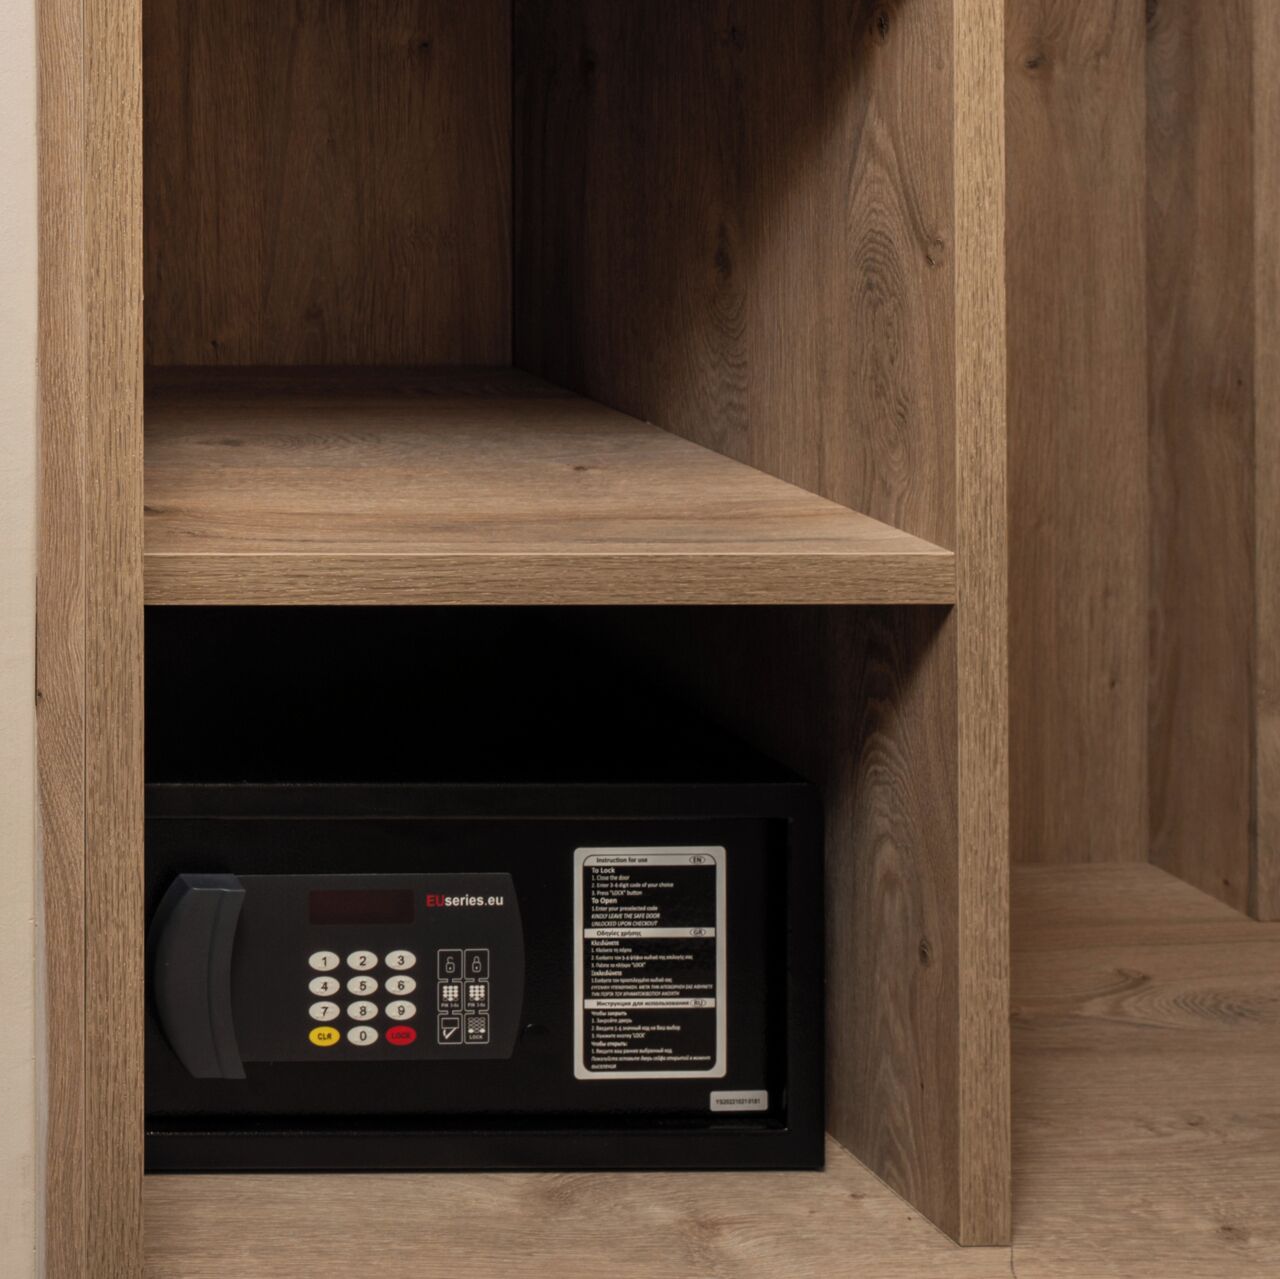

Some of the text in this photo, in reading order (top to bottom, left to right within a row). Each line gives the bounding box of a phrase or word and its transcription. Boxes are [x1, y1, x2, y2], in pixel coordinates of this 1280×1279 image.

[426, 894, 504, 907] EUseries.eu
[600, 897, 617, 905] Open
[321, 955, 405, 967] 1 2 3
[321, 980, 405, 992] 4 5 6
[321, 1005, 405, 1017] 7 8 9
[317, 1032, 332, 1040] CLR
[360, 1031, 367, 1041] 0
